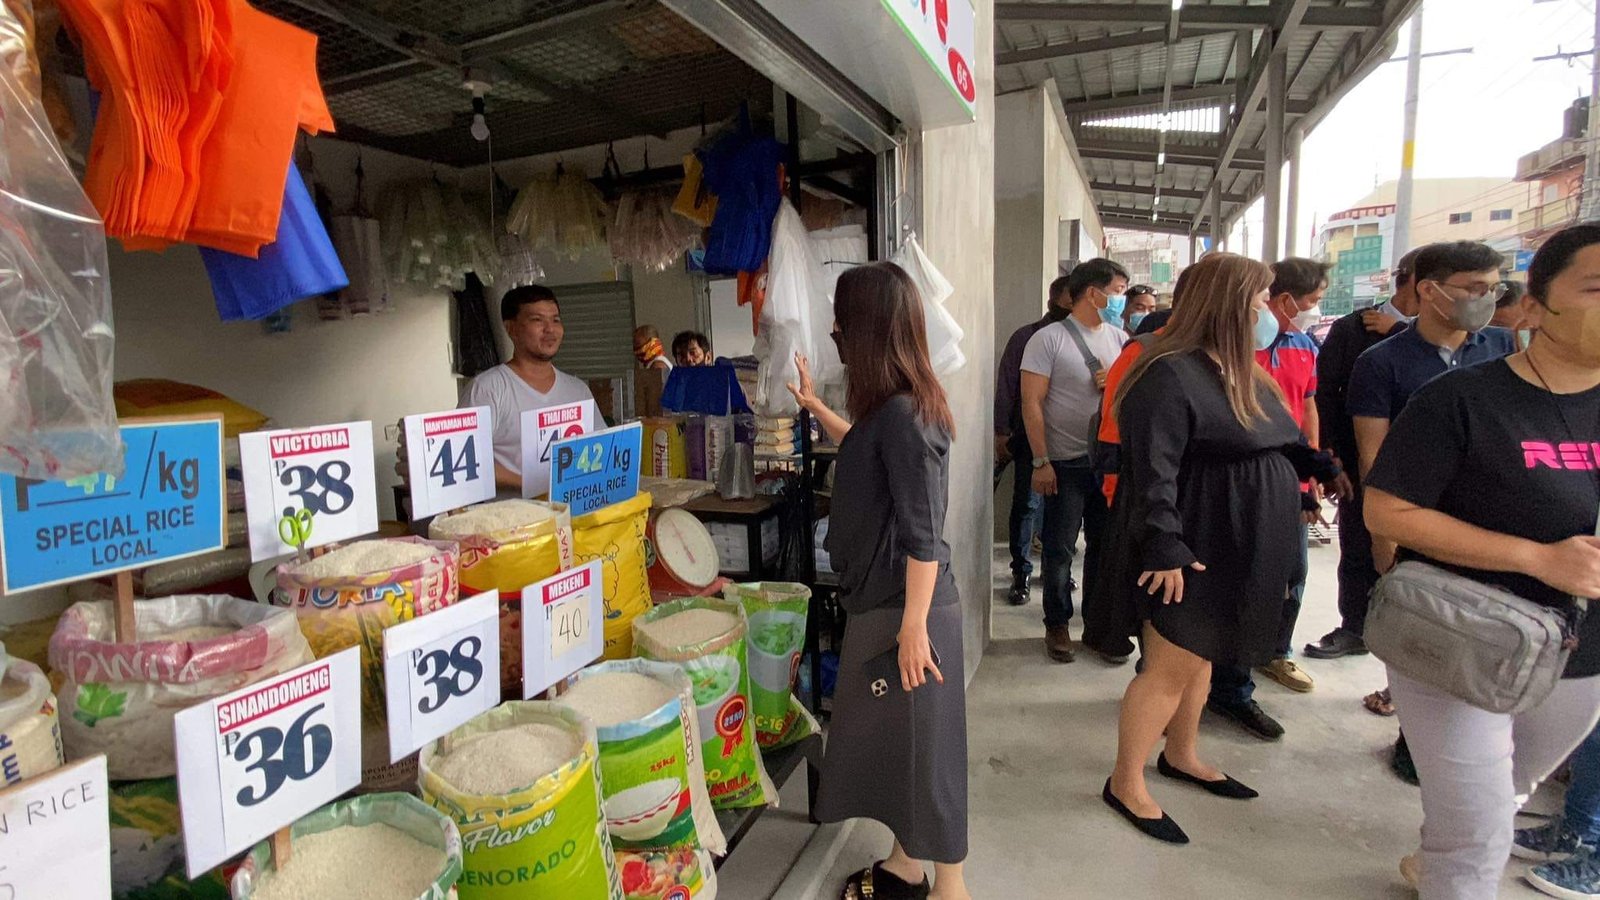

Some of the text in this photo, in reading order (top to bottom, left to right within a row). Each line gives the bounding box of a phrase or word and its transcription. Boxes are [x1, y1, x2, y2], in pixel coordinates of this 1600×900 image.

[543, 407, 578, 425] THAI RICE
[271, 430, 348, 454] VICTORIA
[430, 435, 480, 487] 44
[577, 442, 604, 474] 42
[280, 460, 354, 521] 38
[563, 475, 627, 504] SPECIAL RICE
[583, 495, 609, 511] LOCAL
[36, 505, 195, 551] SPECIAL RICE
[92, 539, 157, 566] LOCAL
[548, 572, 585, 600] MEKENI
[559, 608, 582, 644] 40
[417, 636, 483, 714] 38
[219, 667, 329, 729] SINANDOMENG
[234, 702, 333, 807] 36
[27, 781, 95, 826] RICE
[463, 809, 556, 854] Flavor
